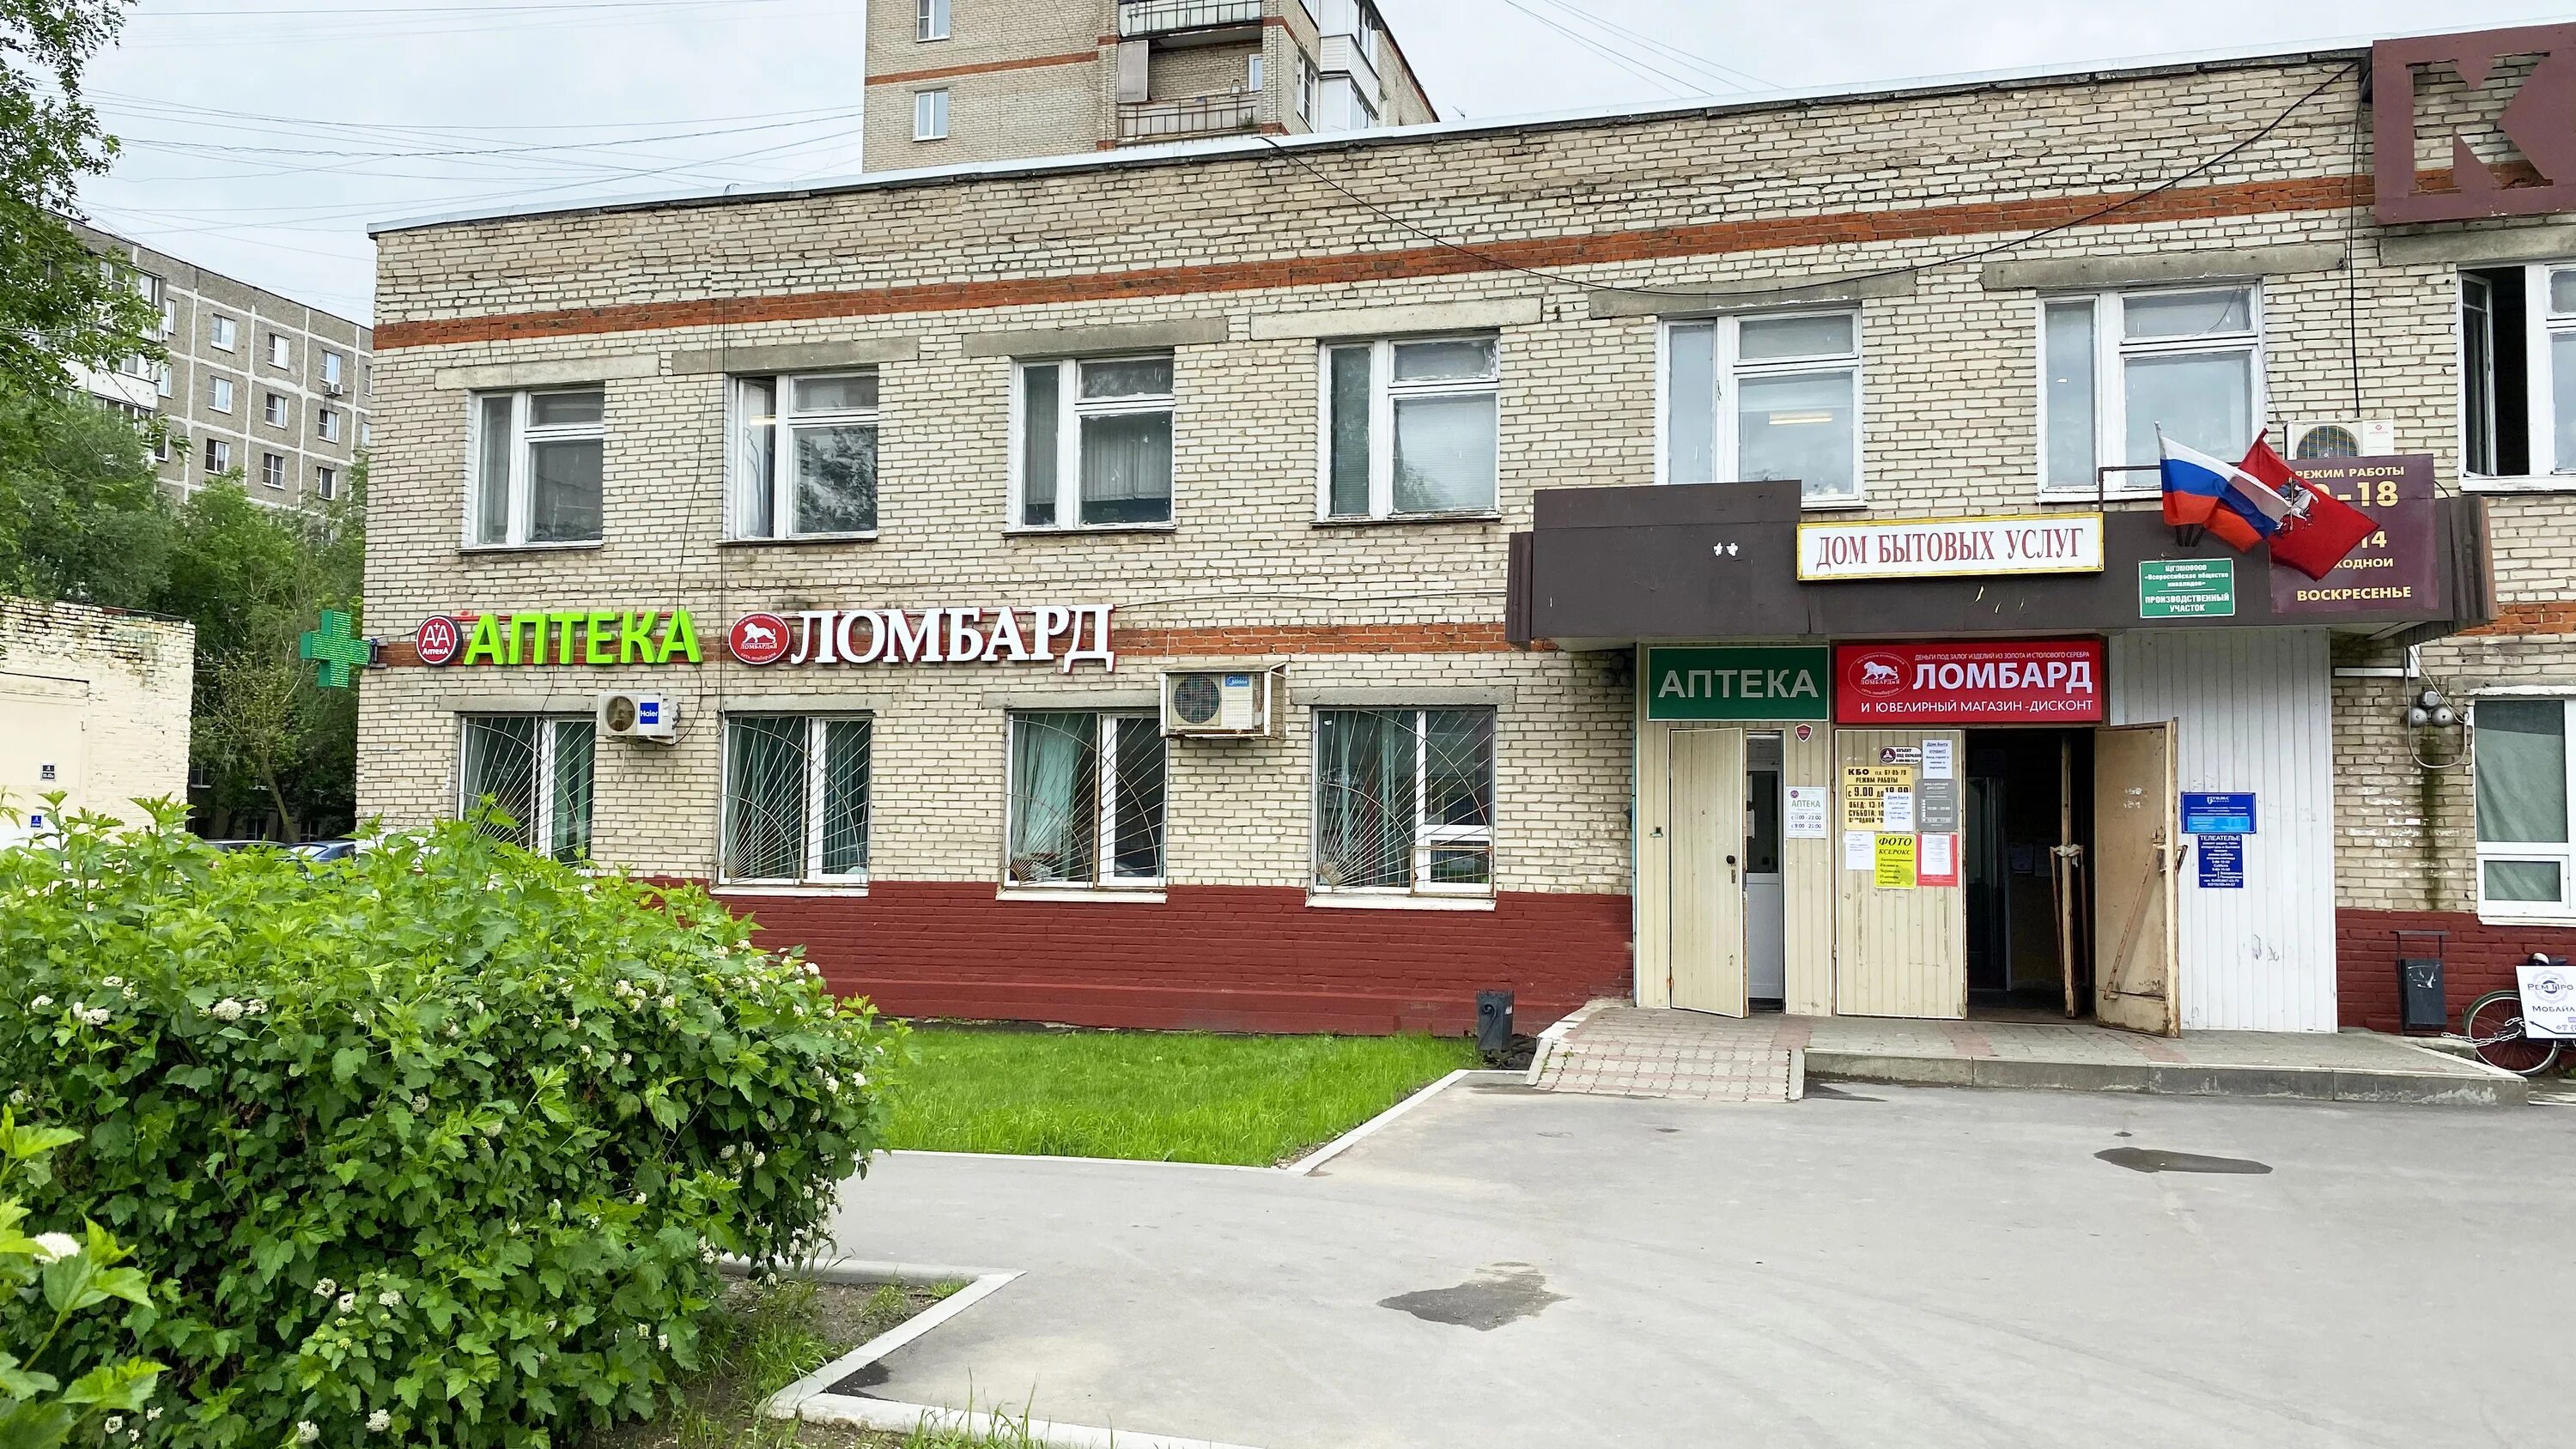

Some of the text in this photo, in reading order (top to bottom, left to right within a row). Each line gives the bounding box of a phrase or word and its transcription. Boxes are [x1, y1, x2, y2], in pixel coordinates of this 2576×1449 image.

[2349, 466, 2404, 477] РАБОТЫ
[1816, 528, 2084, 572] ДОМ БЫТОВЫХ УСЛУГ
[2145, 592, 2230, 603] ПРОИЗВОДСТВЕННЫЙ
[2297, 586, 2411, 601] ВОСКРЕСЕНЬЕ
[463, 609, 702, 666] АПТЕКА
[790, 603, 1115, 673] ЛОМБАРД
[1658, 669, 1820, 698] АПТЕКА
[1912, 661, 2093, 694] ЛОМБАРД
[1862, 702, 1869, 712] И
[1875, 700, 1957, 713] ЮВЕЛИРНЫЙ
[1960, 700, 2022, 712] МАГАЗИН
[1855, 787, 1873, 797] 9.00
[1879, 838, 1912, 846] ФОТО
